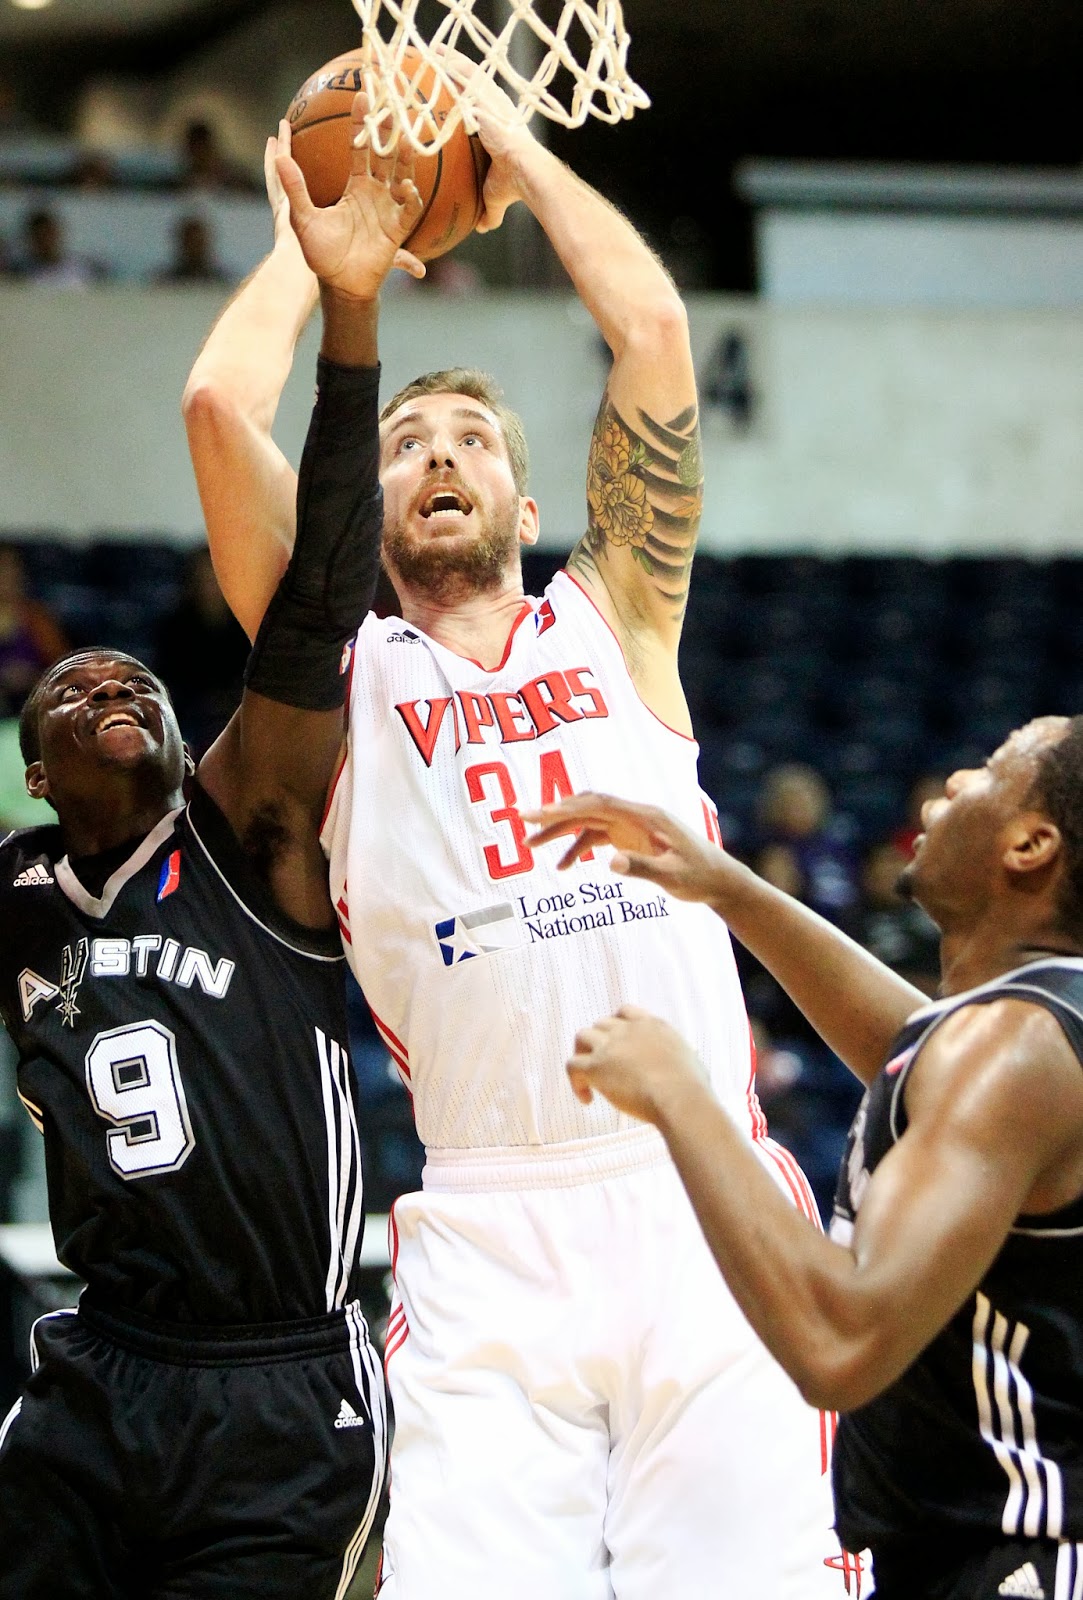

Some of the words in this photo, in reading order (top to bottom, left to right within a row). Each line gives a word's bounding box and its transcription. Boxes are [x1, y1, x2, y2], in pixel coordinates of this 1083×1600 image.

[386, 634, 421, 644] adida
[464, 750, 595, 880] 34
[13, 874, 54, 886] adidas
[518, 892, 576, 919] Lone
[578, 881, 625, 905] Star
[525, 904, 616, 944] National
[618, 895, 670, 923] Bank
[17, 934, 236, 1027] AUSTIN
[84, 1019, 196, 1181] 9
